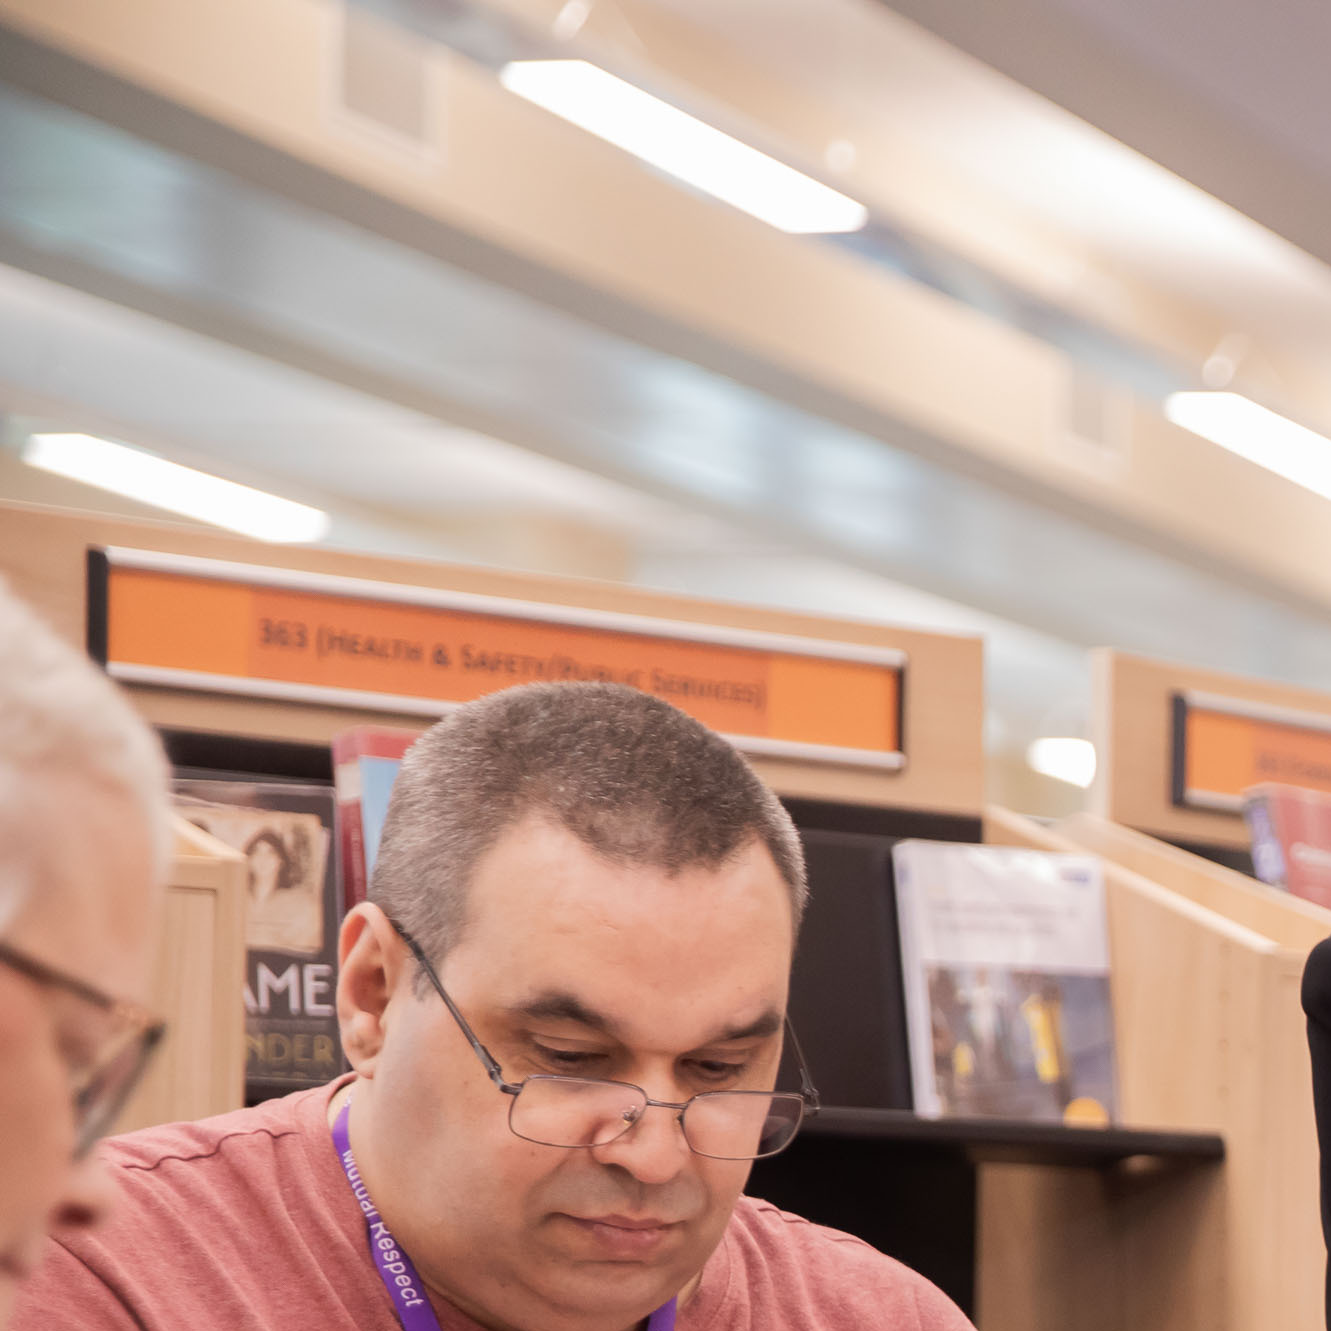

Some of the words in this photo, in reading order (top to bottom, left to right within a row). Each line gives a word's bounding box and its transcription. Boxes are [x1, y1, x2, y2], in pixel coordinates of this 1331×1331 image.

[258, 617, 309, 649] 363
[431, 642, 451, 668] &
[370, 1221, 424, 1307] Respect
